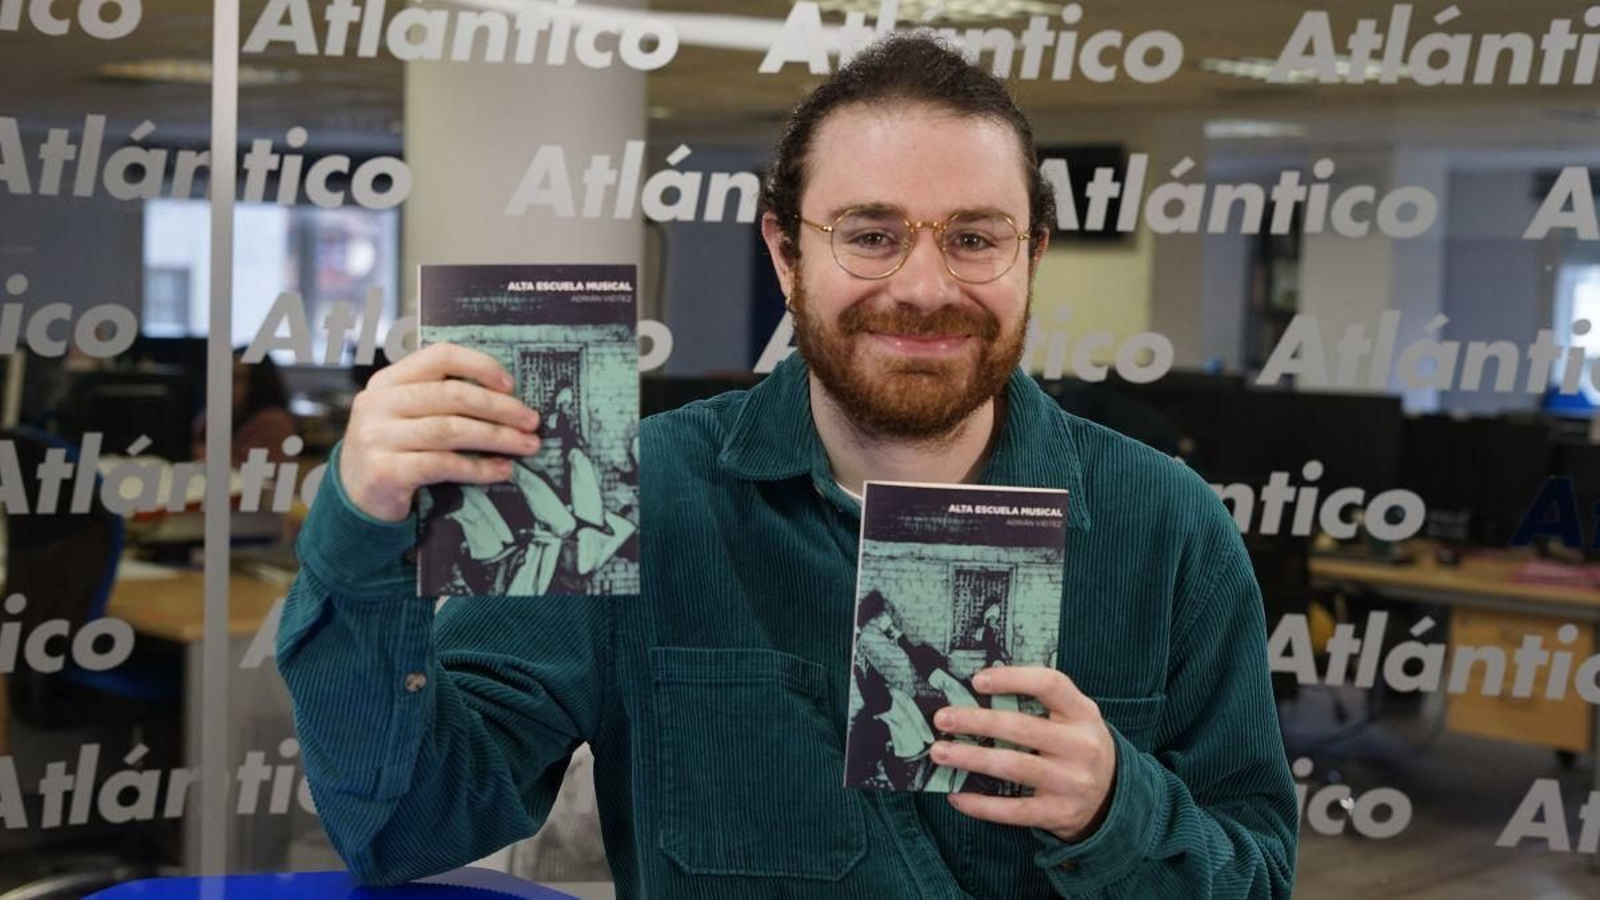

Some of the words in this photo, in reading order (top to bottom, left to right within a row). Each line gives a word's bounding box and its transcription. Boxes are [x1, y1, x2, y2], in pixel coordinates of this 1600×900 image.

[507, 281, 535, 292] ALTA
[536, 281, 585, 292] ESCUELA
[585, 281, 633, 292] MUSICAL
[1255, 310, 1600, 395] Atlánti
[948, 503, 974, 513] ALTA
[975, 504, 1019, 515] ESCUELA
[1020, 507, 1063, 517] MUSICAL
